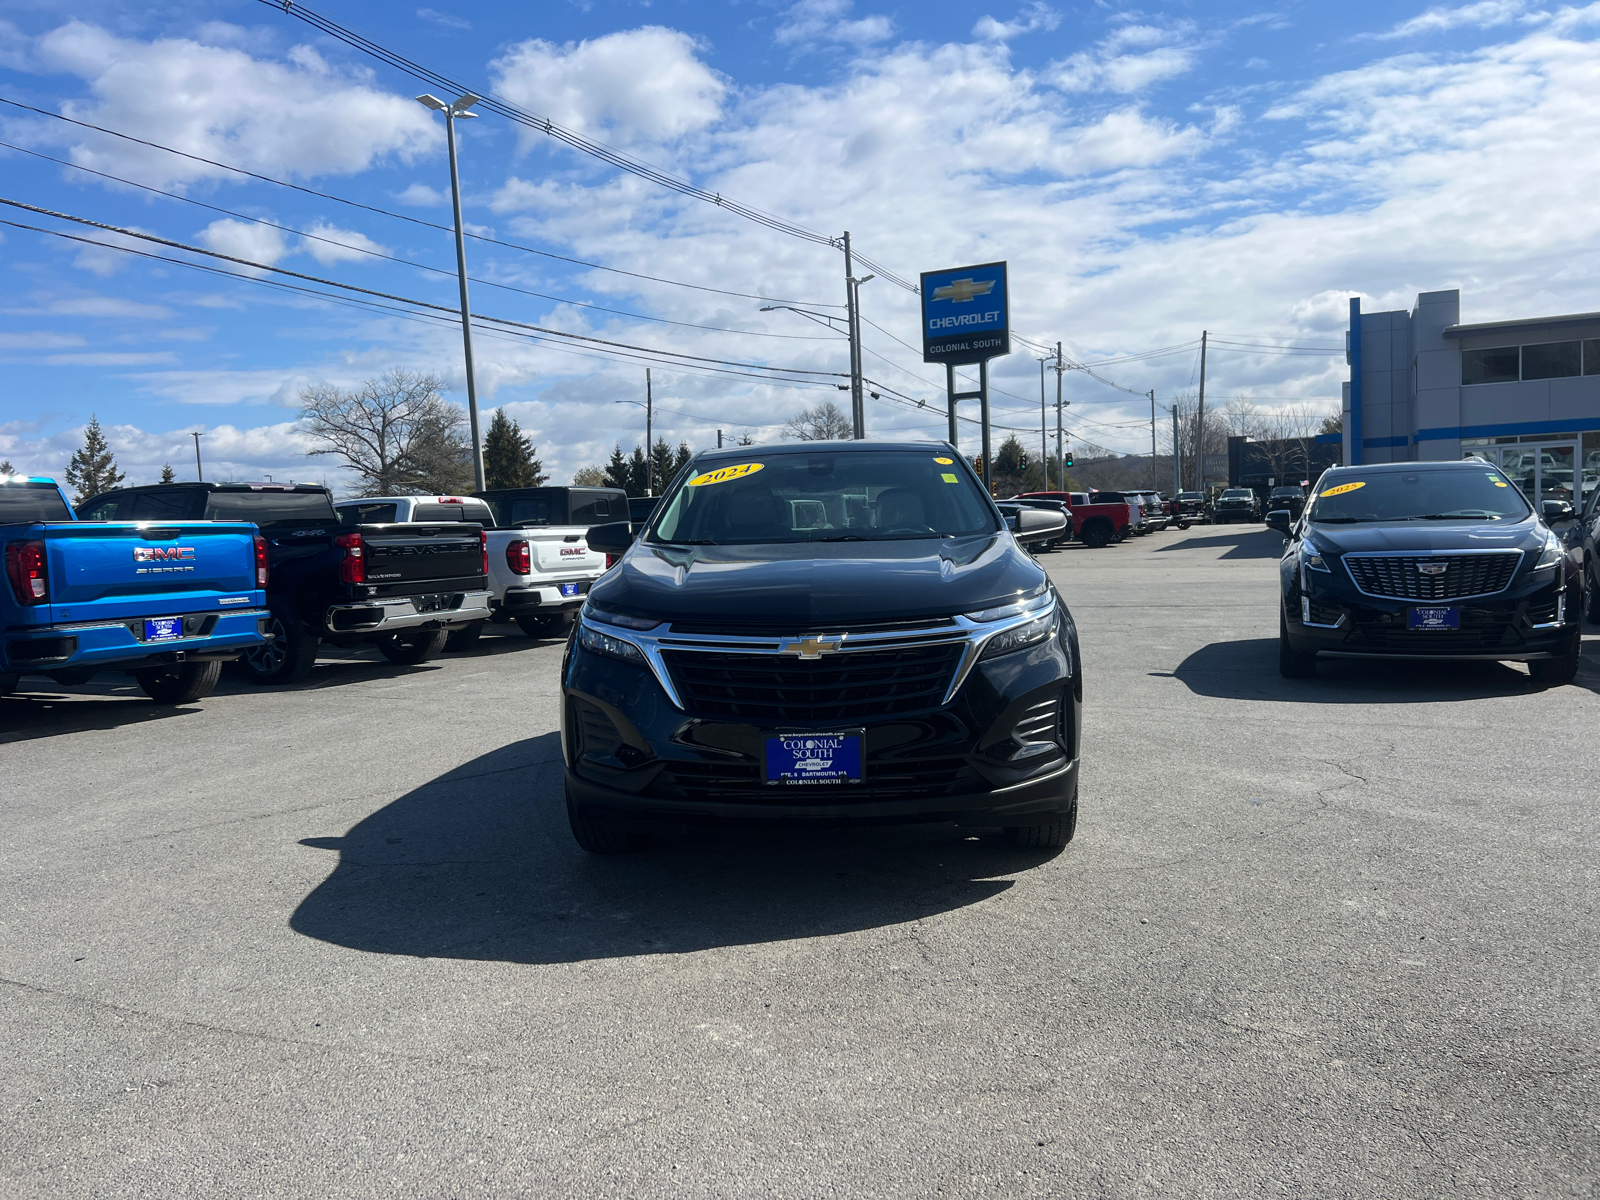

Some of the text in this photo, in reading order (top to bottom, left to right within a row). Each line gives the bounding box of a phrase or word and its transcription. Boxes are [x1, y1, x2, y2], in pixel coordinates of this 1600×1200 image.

[929, 311, 1000, 329] CHEVROLET
[930, 339, 1001, 353] COLONIAL SOUTH
[701, 464, 752, 484] 2024
[1330, 483, 1357, 495] 2025
[133, 547, 195, 561] GMC
[374, 545, 478, 556] CHEVROLET
[559, 548, 586, 556] GMC
[136, 566, 194, 574] SIERRA
[783, 739, 842, 749] COLONIAL
[792, 749, 833, 758] SOUTH
